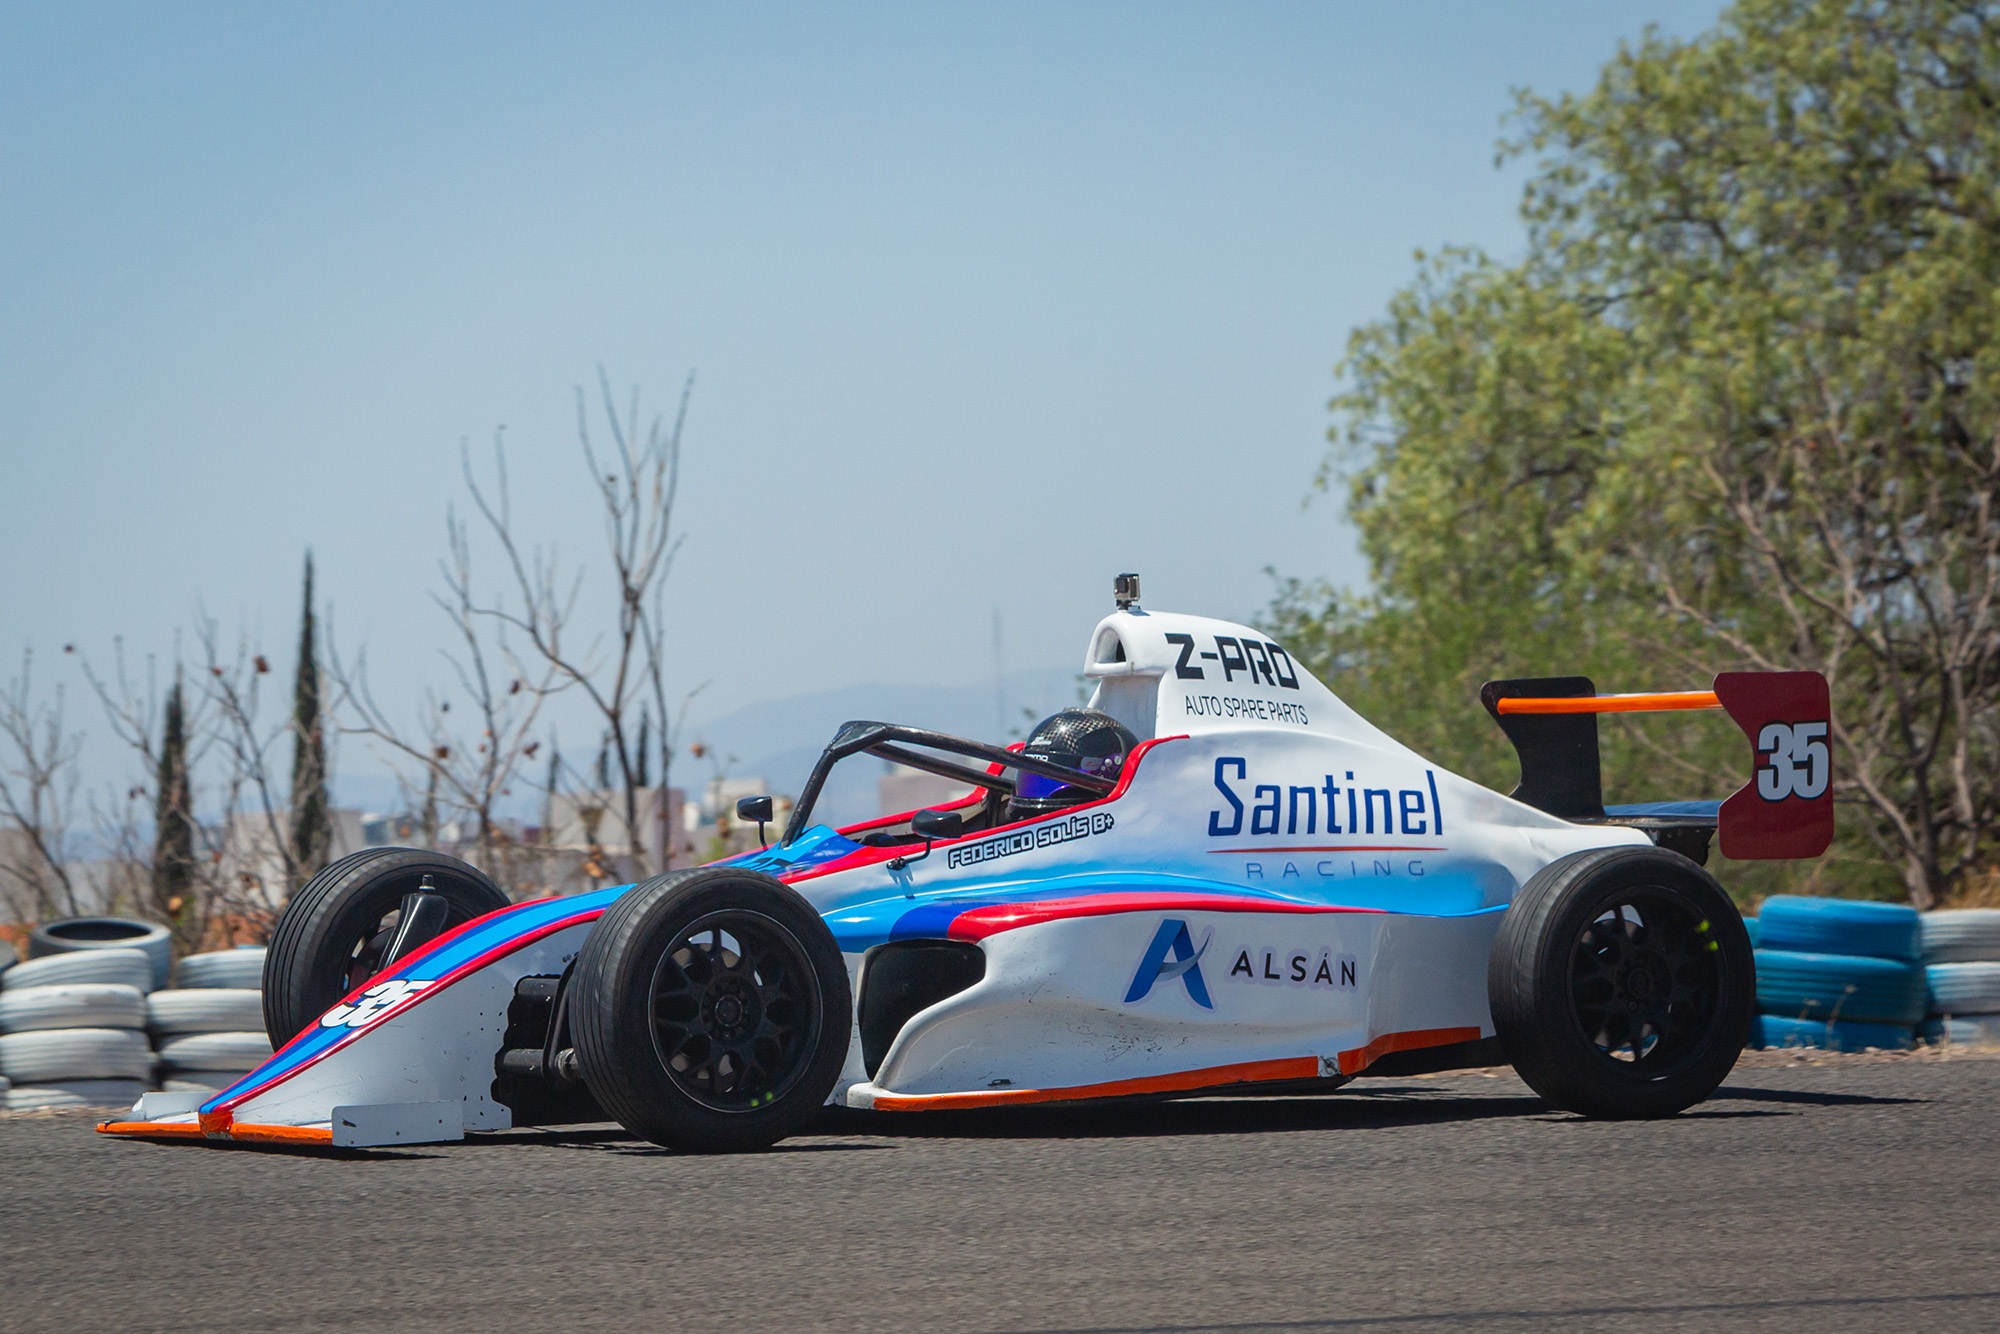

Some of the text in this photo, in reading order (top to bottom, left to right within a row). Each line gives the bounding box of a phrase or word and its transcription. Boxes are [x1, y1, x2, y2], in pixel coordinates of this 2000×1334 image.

[1164, 632, 1300, 690] Z-PRO
[1185, 695, 1309, 726] AUTO SPARE PARTS
[1757, 721, 1830, 802] 35
[1207, 756, 1443, 837] Santinel
[948, 830, 1034, 869] FEDERICO
[1092, 813, 1115, 835] B+
[1246, 860, 1425, 879] RACING
[1230, 950, 1356, 987] ALSÁN
[320, 979, 437, 1028] 35
